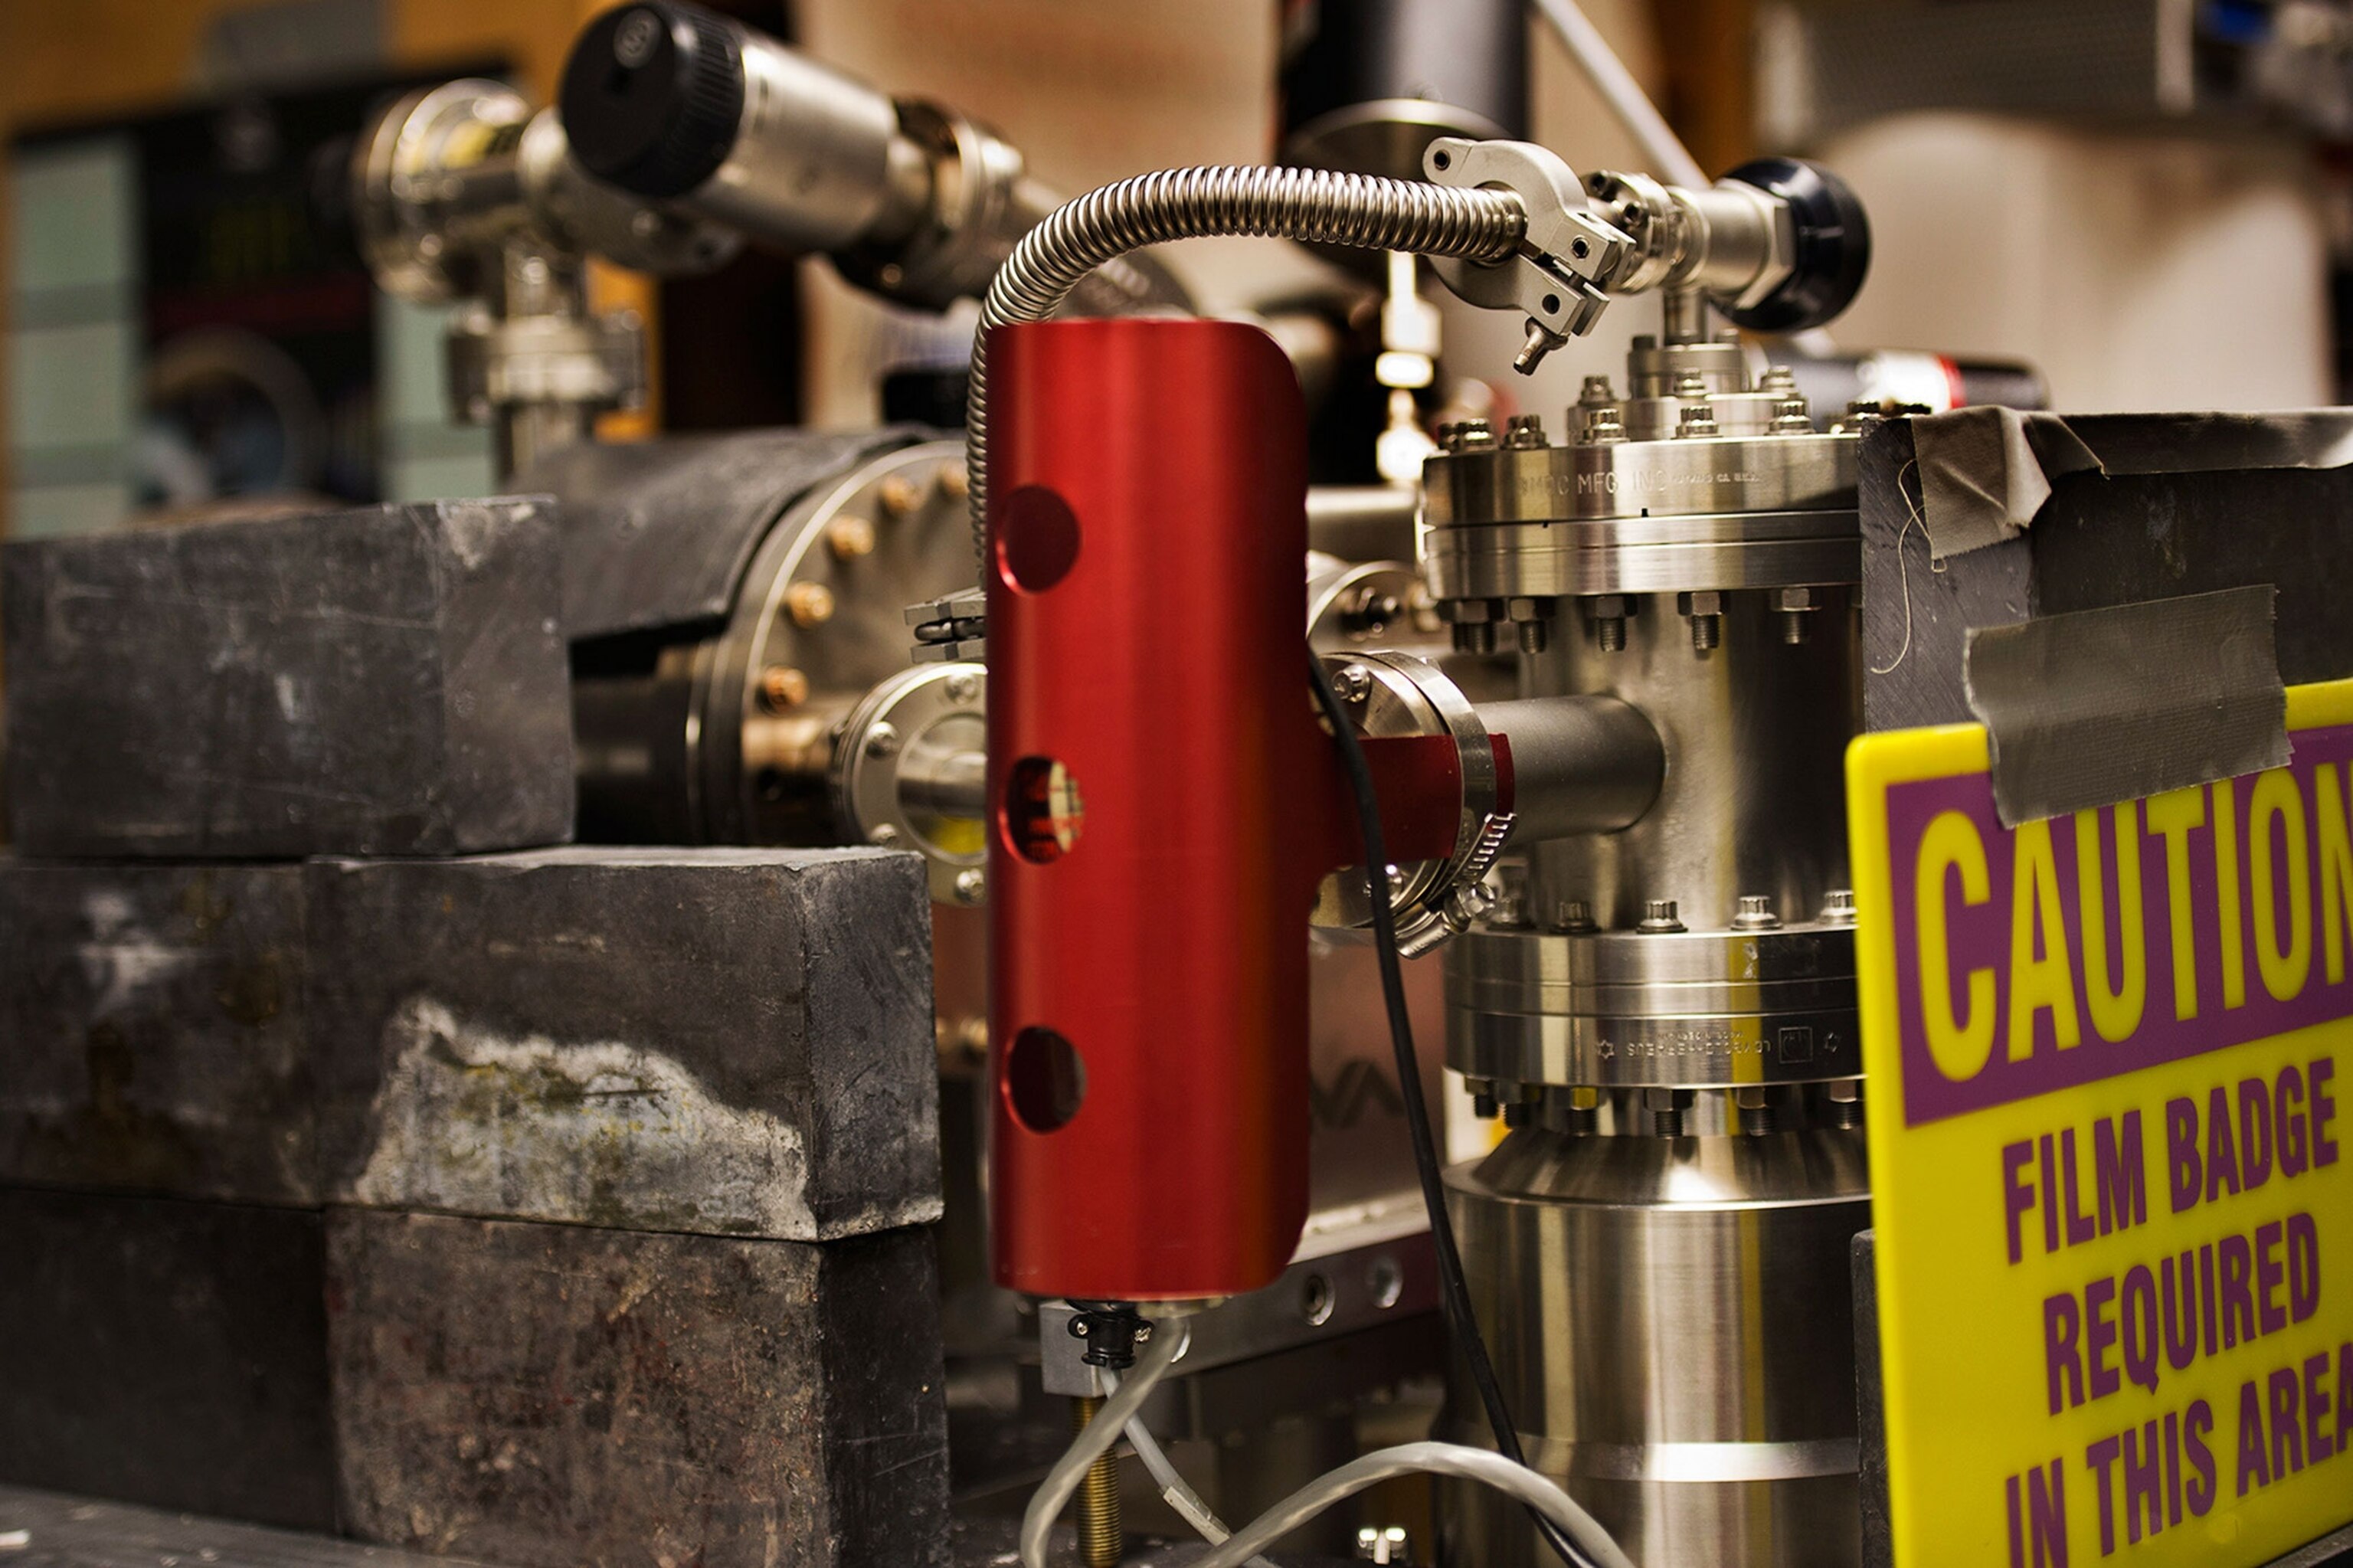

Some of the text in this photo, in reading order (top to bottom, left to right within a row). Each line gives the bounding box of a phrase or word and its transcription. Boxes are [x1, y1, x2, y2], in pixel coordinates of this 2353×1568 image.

[1577, 471, 1619, 495] MFG
[1917, 761, 2353, 1083] CAUTION
[2002, 1056, 2340, 1267] FILM BADGE
[2043, 1212, 2321, 1417] REQUIRED
[2006, 1457, 2069, 1568] IN
[2086, 1399, 2217, 1558] THIS
